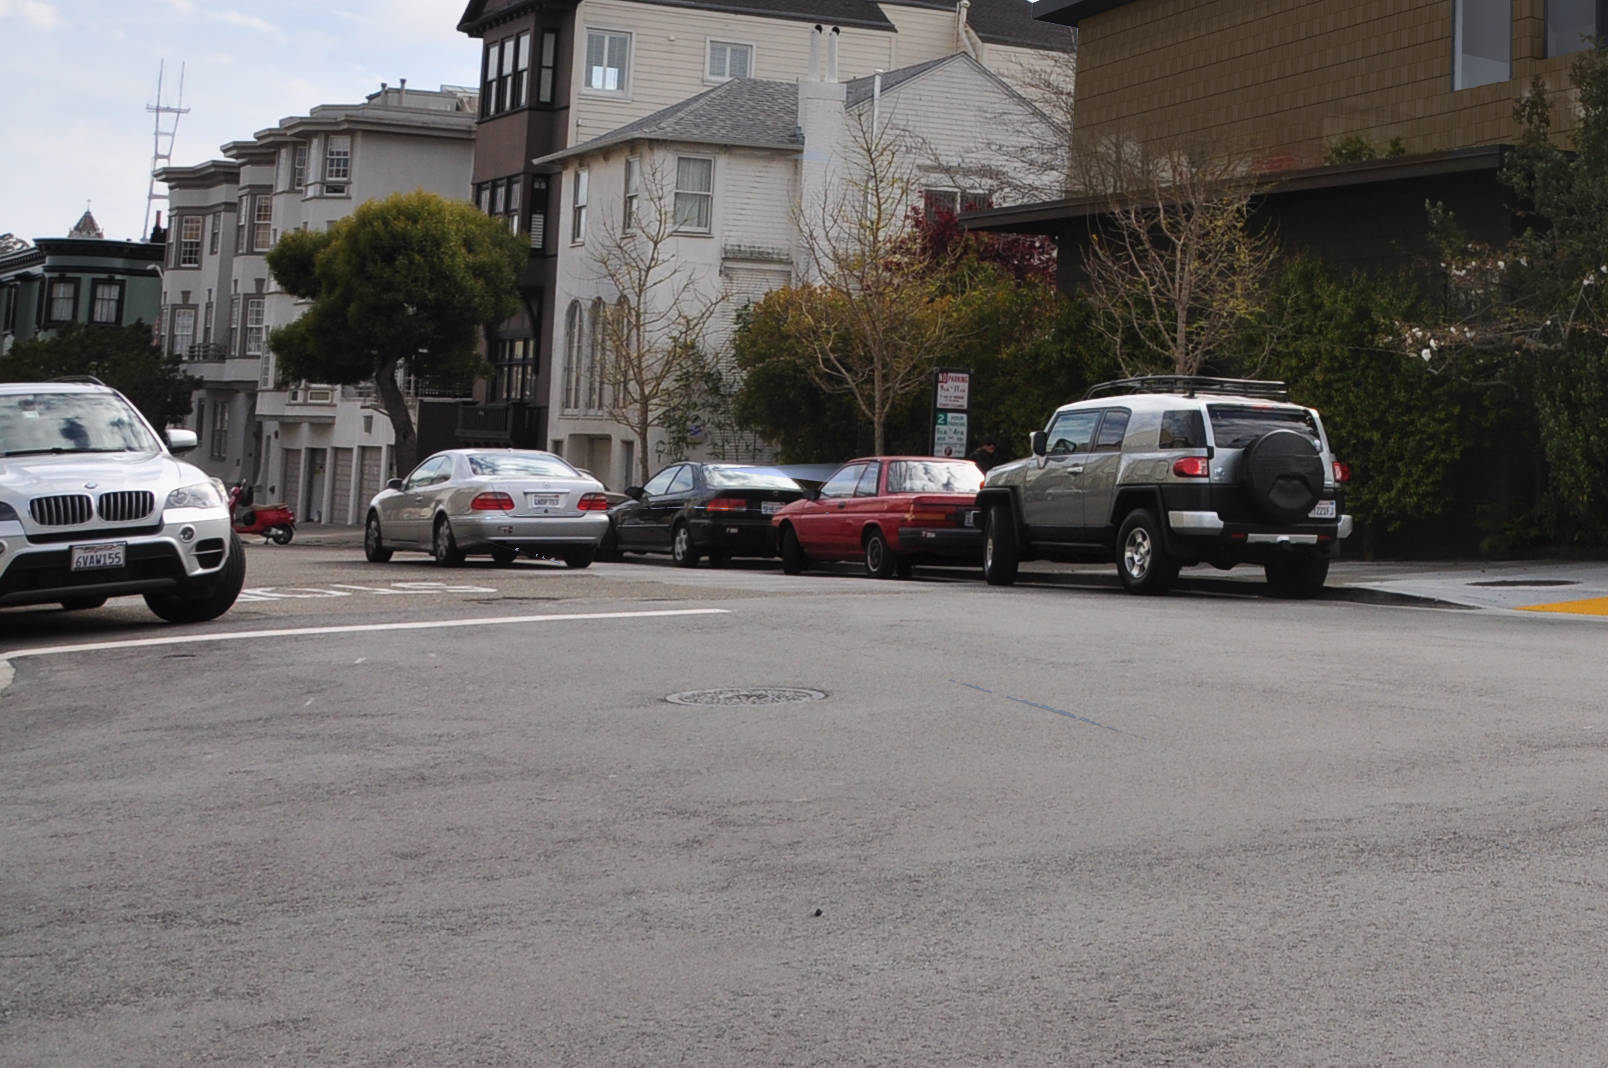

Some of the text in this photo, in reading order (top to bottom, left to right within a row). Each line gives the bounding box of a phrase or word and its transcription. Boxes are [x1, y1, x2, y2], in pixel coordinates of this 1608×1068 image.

[948, 375, 968, 383] PARKING
[937, 414, 945, 424] 2
[75, 552, 121, 567] 6VAW155
[237, 582, 498, 602] STO
